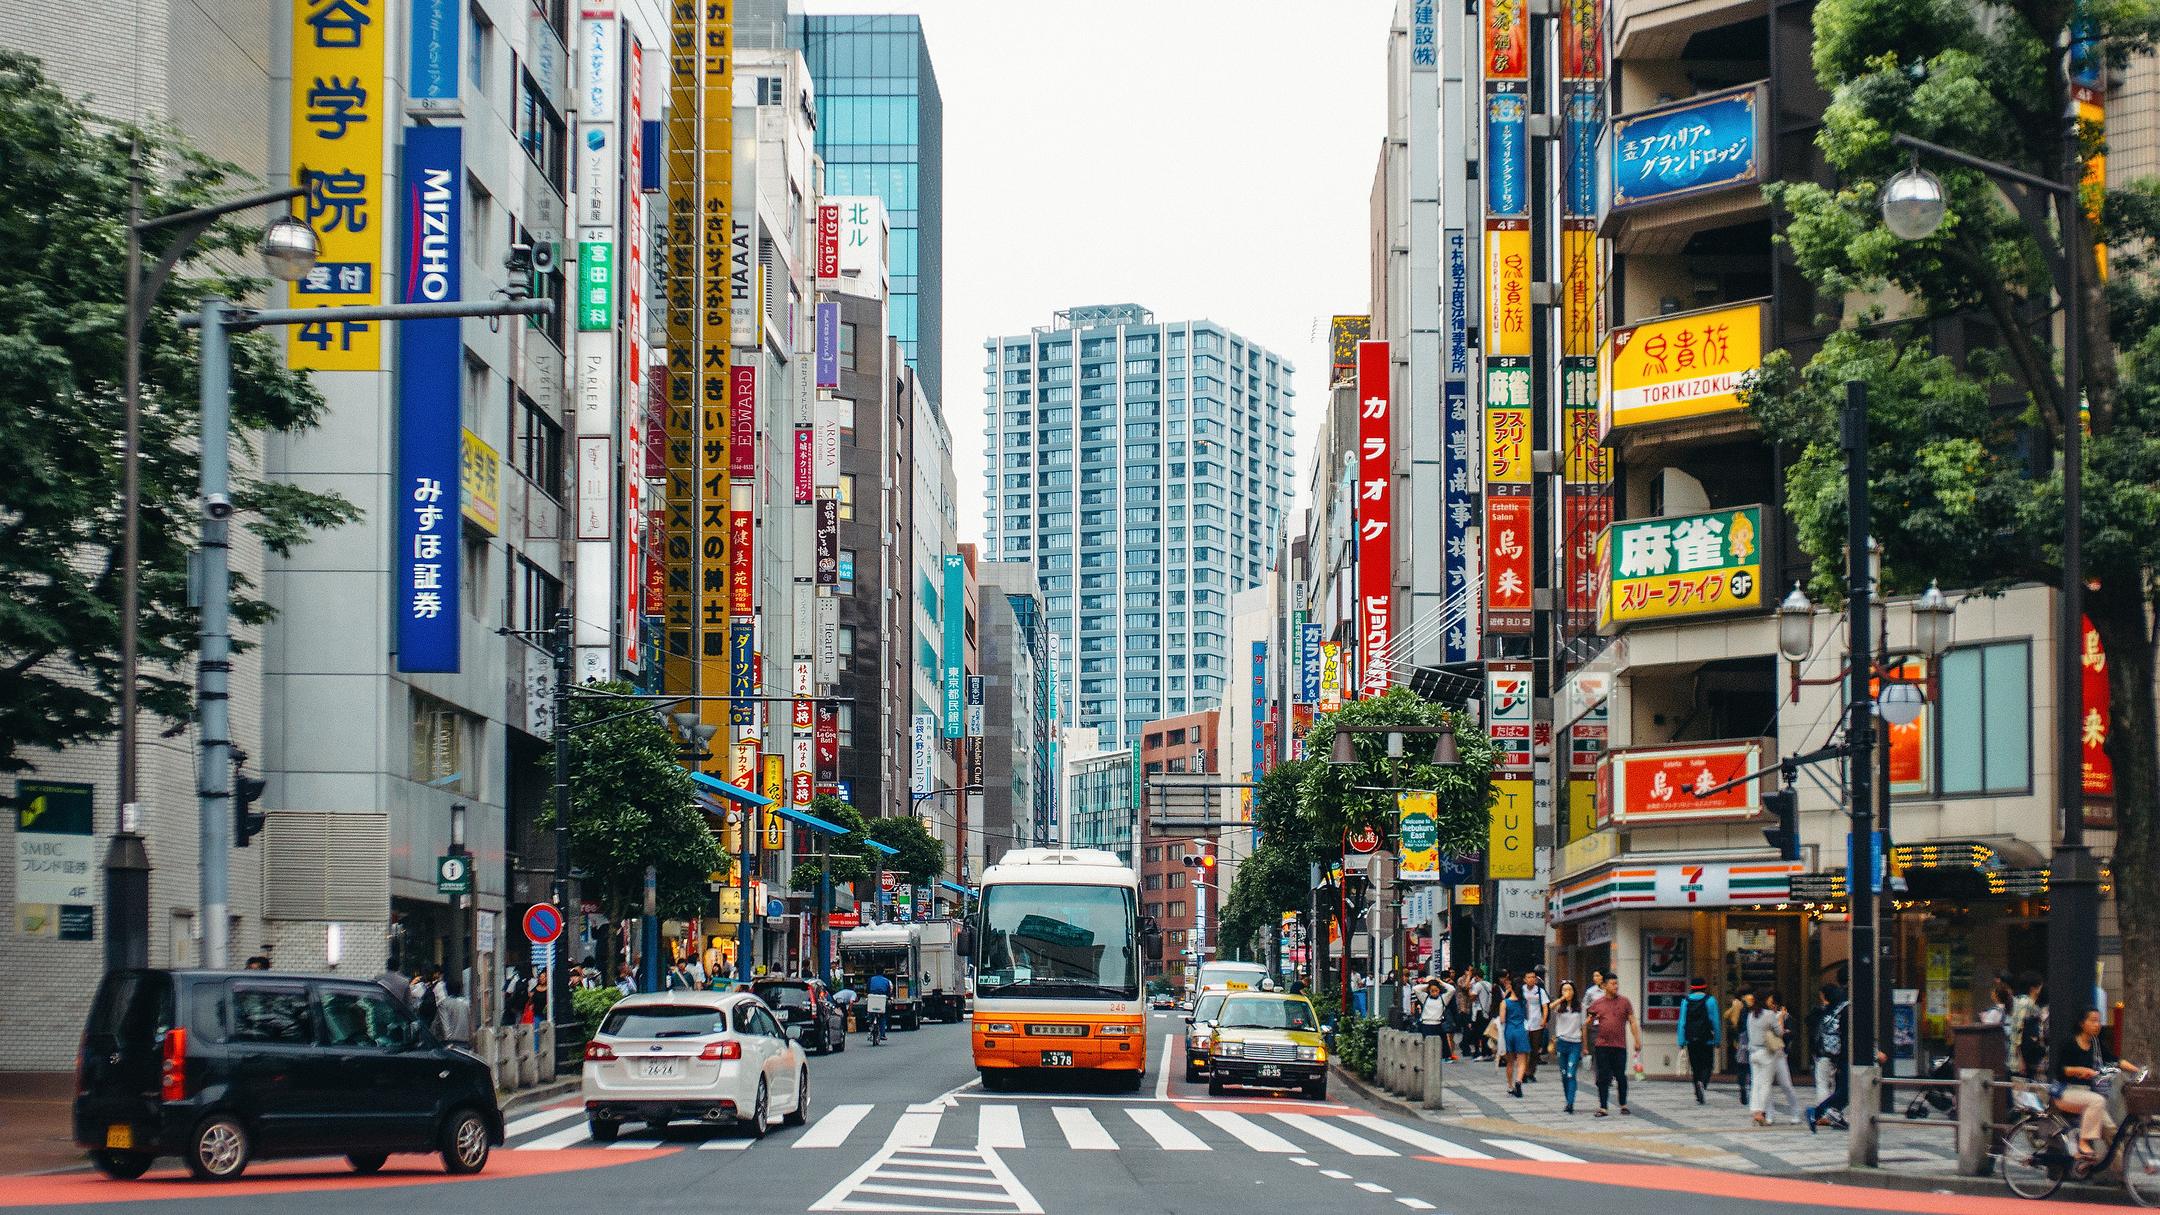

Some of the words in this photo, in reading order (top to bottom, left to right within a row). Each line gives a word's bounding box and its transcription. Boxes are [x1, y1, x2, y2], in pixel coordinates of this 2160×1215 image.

[1639, 137, 1748, 181] グランドロッジ
[423, 168, 450, 300] MIZUHO
[1497, 221, 1516, 230] 4F
[705, 197, 725, 326] 小さいサイズから
[304, 267, 363, 291] 受付
[1615, 333, 1631, 345] 4F
[1500, 358, 1517, 367] 3F
[1488, 370, 1530, 406] 麻雀
[738, 370, 752, 446] EDWARD
[827, 420, 836, 467] AROMA
[1492, 411, 1511, 477] ファイブ
[1509, 411, 1525, 461] スリー
[1363, 395, 1388, 541] カラオケ
[1497, 486, 1522, 496] 2F
[734, 518, 748, 526] 4F
[1491, 513, 1514, 522] Salon
[412, 477, 444, 619] みずほ証券
[1619, 517, 1725, 577] 麻雀
[1731, 574, 1752, 595] 3F
[824, 623, 835, 664] Hearth
[1504, 664, 1517, 672] 1F
[947, 667, 960, 735] 東京都民銀行
[1496, 726, 1525, 736] たばこ
[974, 767, 982, 784] Club
[1504, 772, 1518, 780] B1
[796, 775, 810, 800] 王将
[20, 841, 63, 857] SMBC
[22, 859, 89, 875] フレンド証券
[68, 886, 88, 898] 4F
[1110, 1003, 1127, 1011] 249
[1052, 1055, 1072, 1066] 978
